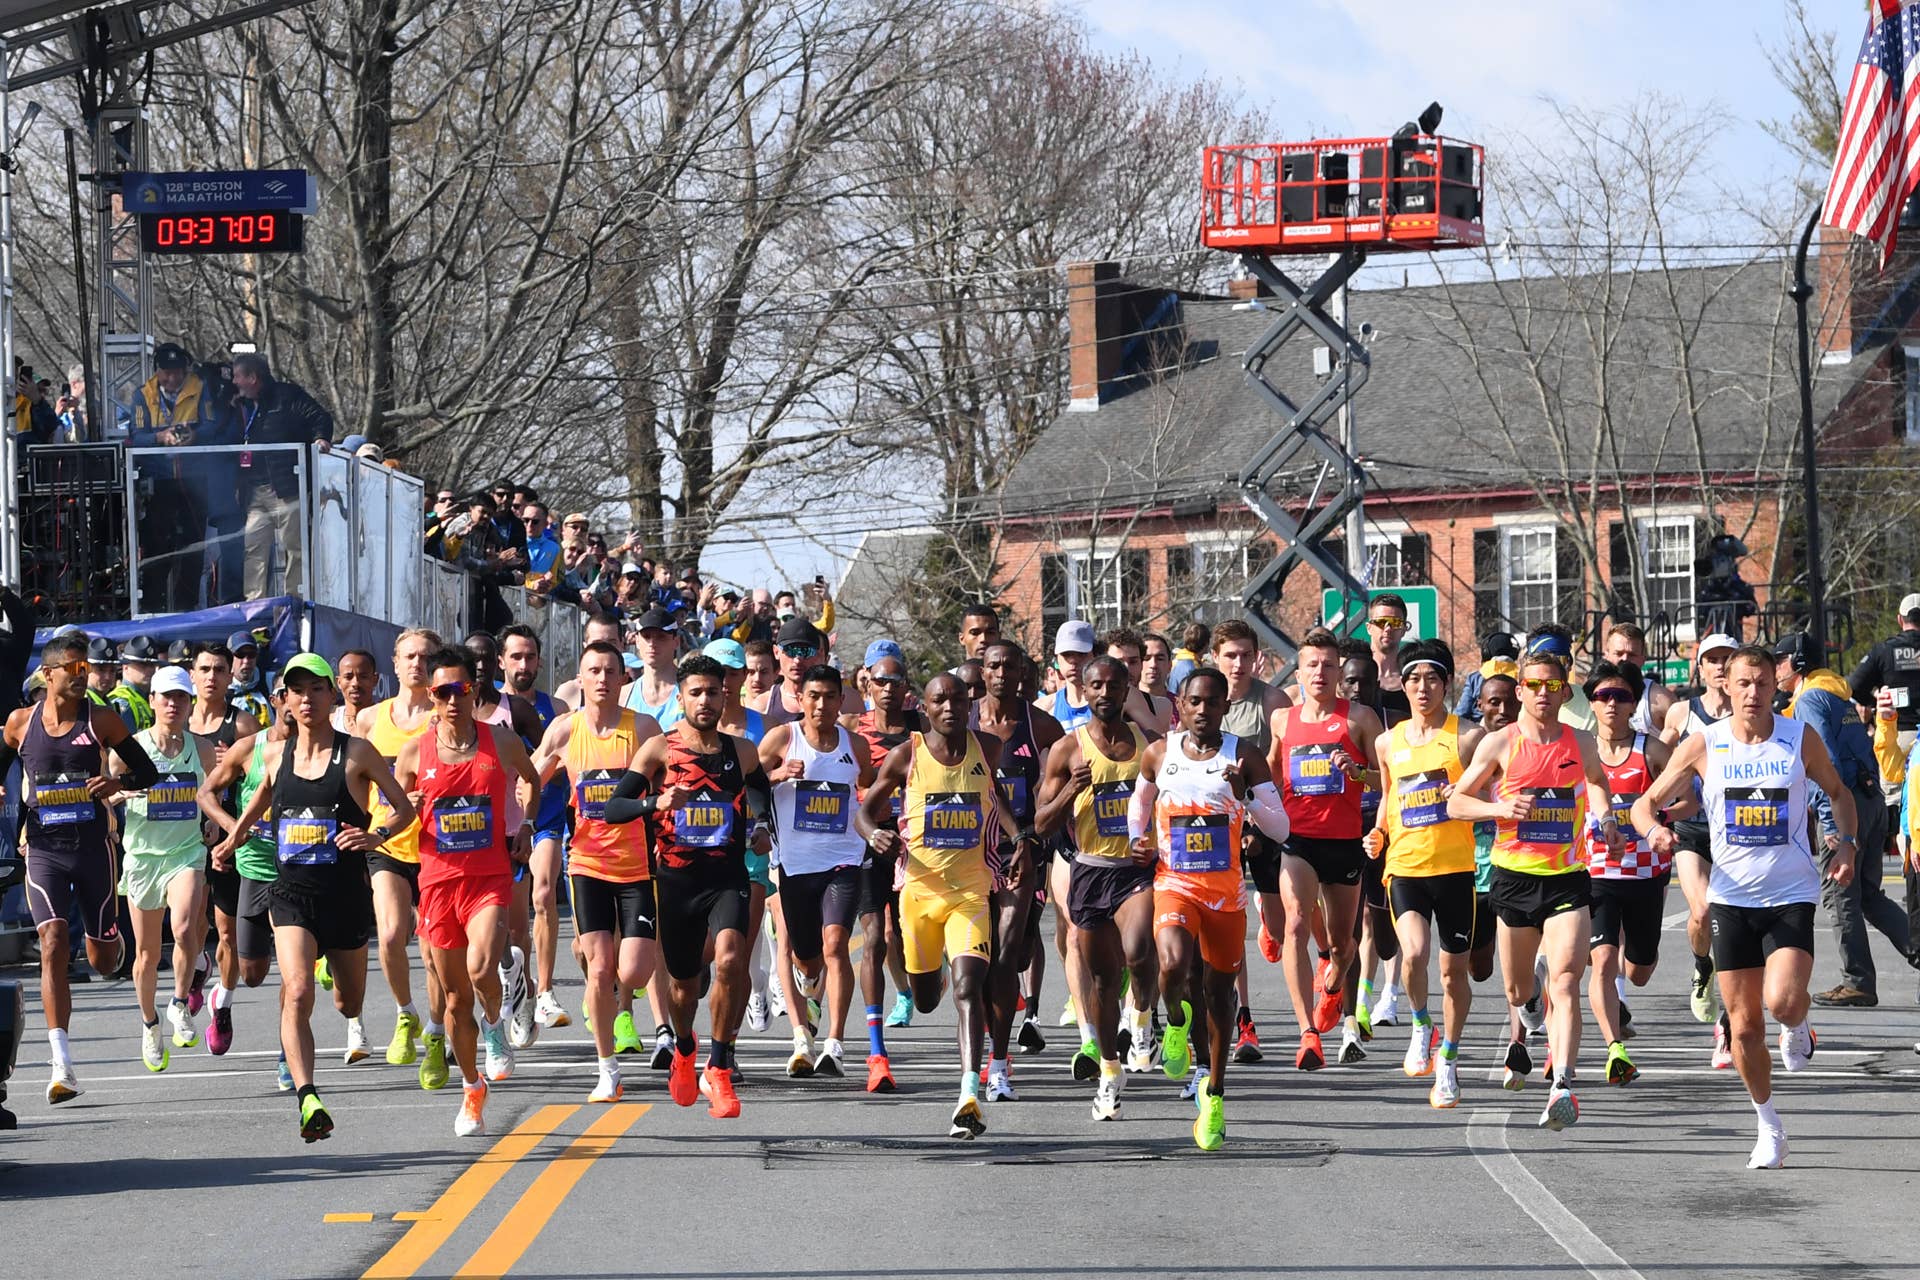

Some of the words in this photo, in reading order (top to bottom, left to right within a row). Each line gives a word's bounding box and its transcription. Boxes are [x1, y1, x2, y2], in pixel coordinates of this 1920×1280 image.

[192, 181, 243, 192] BOSTON
[166, 192, 243, 203] MARATHON
[158, 215, 274, 245] 09:37:09
[1723, 760, 1789, 779] UKRAINE
[148, 786, 197, 804] AKIYAMA
[805, 796, 840, 815] JAMI
[1525, 807, 1575, 822] BERTSON
[440, 812, 486, 833] CHENG
[684, 807, 724, 827] TALBI
[932, 810, 978, 829] EVANS
[1185, 832, 1214, 853] ESA
